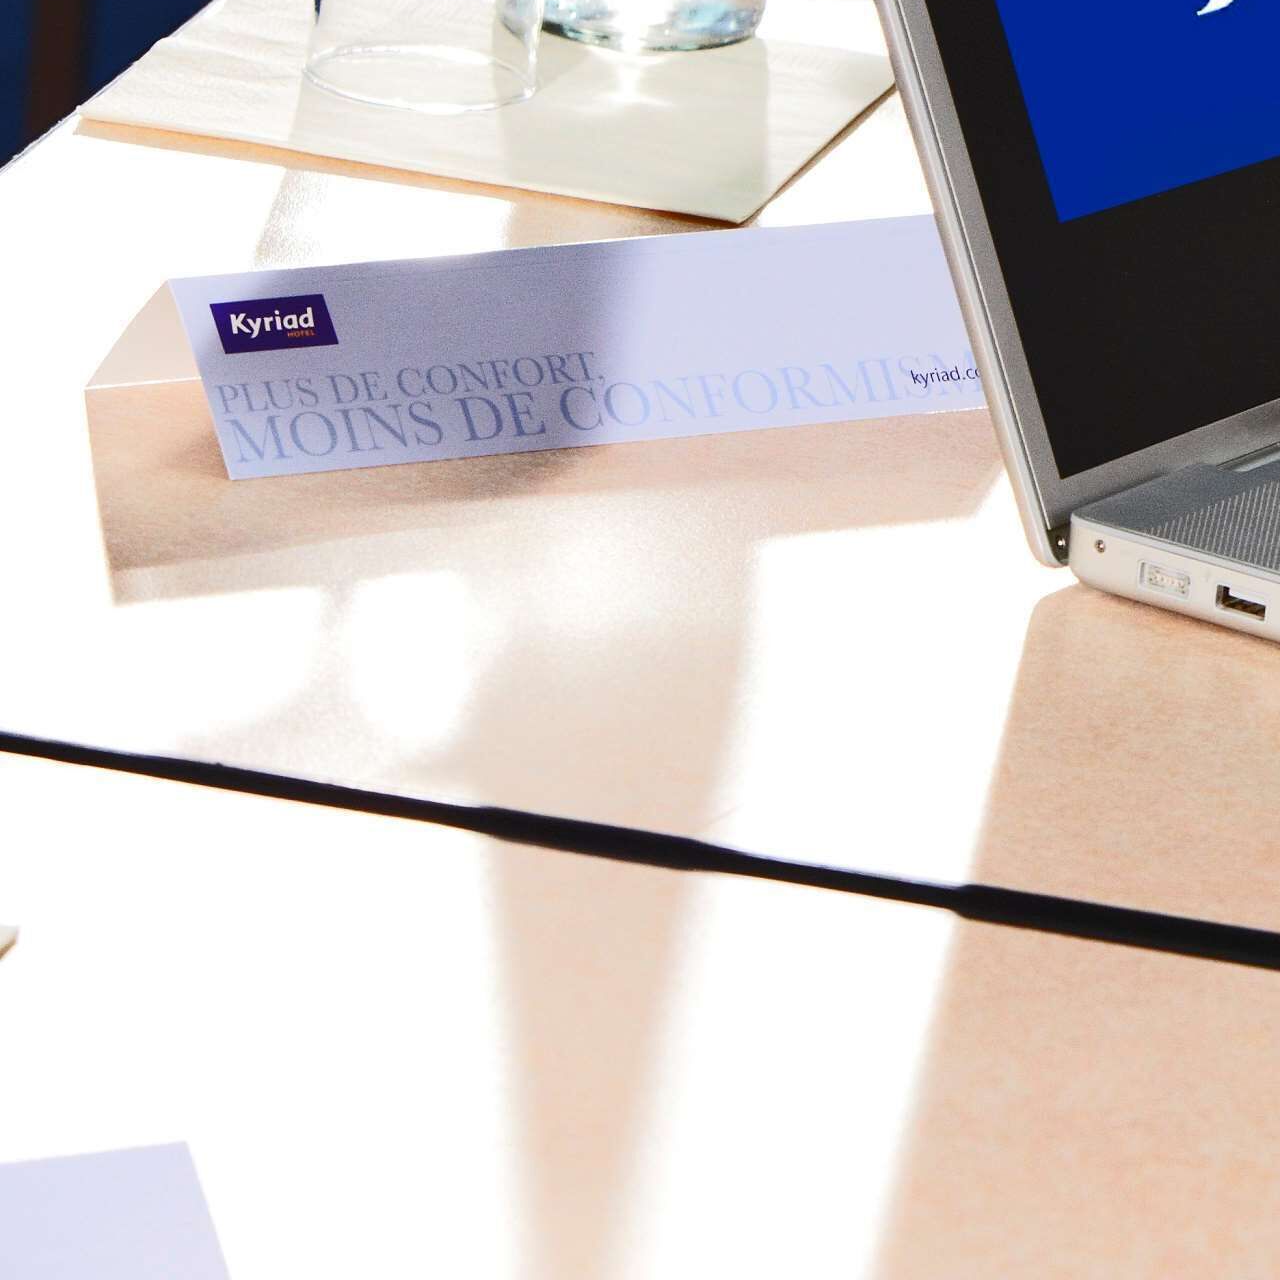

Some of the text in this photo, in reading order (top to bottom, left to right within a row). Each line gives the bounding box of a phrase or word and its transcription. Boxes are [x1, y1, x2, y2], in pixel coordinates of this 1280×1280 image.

[229, 306, 315, 339] Kyriad
[287, 329, 316, 339] HOTEL
[216, 351, 606, 414] PLUS DE CONFORT,
[226, 400, 443, 464] MOINS
[455, 390, 546, 441] DE
